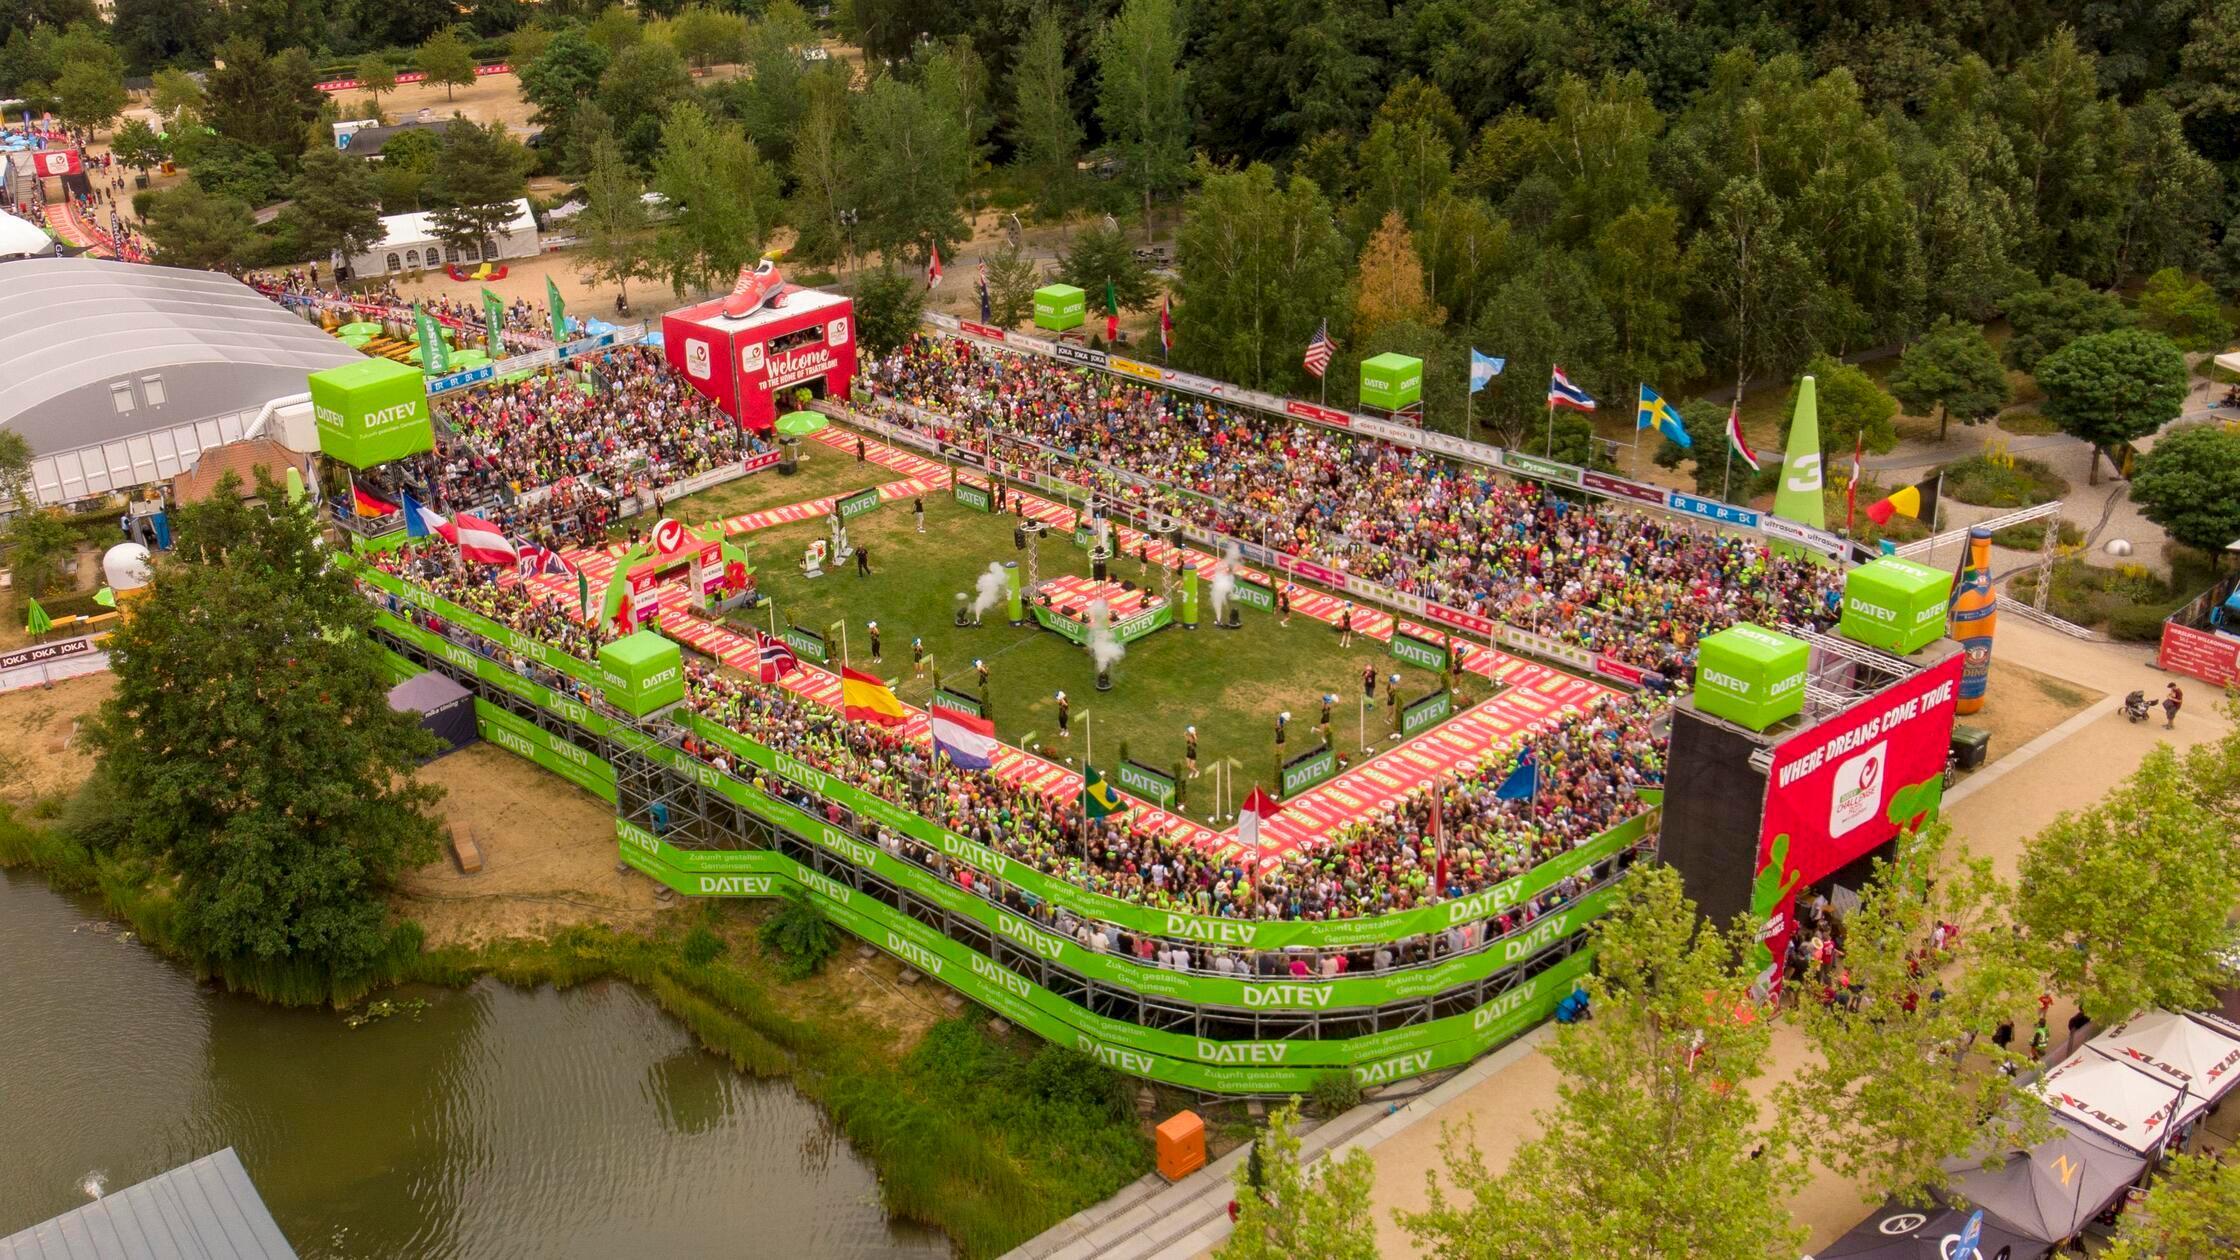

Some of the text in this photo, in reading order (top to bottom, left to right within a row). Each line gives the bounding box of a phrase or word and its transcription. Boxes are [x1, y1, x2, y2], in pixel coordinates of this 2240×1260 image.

[765, 349, 829, 379] Welcome
[435, 369, 489, 390] BR BR BR BR
[759, 381, 768, 391] TO
[768, 378, 779, 388] THE
[779, 373, 797, 386] HOME
[797, 371, 805, 382] OF
[1364, 377, 1389, 390] DATEV
[316, 405, 344, 428] DATEV
[364, 401, 416, 428] DATEV
[1522, 461, 1557, 476] Pyraser
[841, 494, 878, 517] DATEV
[957, 488, 985, 507] DATEV
[1674, 498, 1751, 524] BR BR BR BR
[1764, 519, 1840, 549] ultrasun ultrasun
[1879, 559, 1929, 577] DATEV
[1232, 581, 1270, 608] DATEV
[1850, 598, 1897, 622] DATEV
[1917, 600, 1948, 623] DATEV
[1050, 614, 1079, 635] DATEV
[1122, 614, 1155, 637] DATEV
[1733, 628, 1785, 647] DATEV
[2, 641, 86, 667] JOKA JOKA JOKA
[446, 645, 478, 672] DATEV
[787, 634, 822, 657] DATEV
[1394, 641, 1442, 667] DATEV
[603, 670, 627, 689] DATEV
[643, 667, 676, 689] DATEV
[1703, 668, 1750, 694] DATEV
[1770, 671, 1805, 696] DATEV
[550, 693, 587, 721] DATEV
[1405, 699, 1447, 730] DATEV
[498, 728, 534, 757] DATEV
[1779, 679, 1953, 789] WHERE DREAMS COME TRUE
[549, 736, 587, 766] DATEV
[675, 754, 720, 787] DATEV
[774, 754, 826, 790] DATEV
[1121, 768, 1170, 797] DATEV
[1287, 757, 1331, 790] DATEV
[616, 818, 659, 854] DATEV
[823, 828, 876, 867] DATEV
[944, 834, 1006, 875] DATEV
[701, 877, 771, 893] DATEV
[798, 866, 849, 903] DATEV
[1450, 881, 1521, 922] DATEV
[998, 915, 1064, 959] DATEV
[1167, 914, 1257, 944] DATEV
[1311, 917, 1404, 935] Zukunft gestalten.
[1324, 931, 1389, 944] Gemeinsam.
[1504, 915, 1568, 960] DATEV
[888, 931, 942, 974] DATEV
[971, 953, 1031, 998] DATEV
[1105, 959, 1191, 988] Zukunft gestalten.
[1385, 973, 1424, 989] Zukunft
[1243, 985, 1333, 1007] DATEV
[1473, 982, 1537, 1030] DATEV
[1077, 1034, 1155, 1073] DATEV
[1198, 1041, 1287, 1063] DATEV
[1341, 1038, 1380, 1051] Zukunft
[1204, 1068, 1296, 1081] Zukunft gestalten.
[1354, 1050, 1433, 1084] DATEV
[2111, 1047, 2193, 1082] XLAB
[1217, 1080, 1281, 1089] Gemeinsam.
[2049, 1091, 2128, 1131] XLAB
